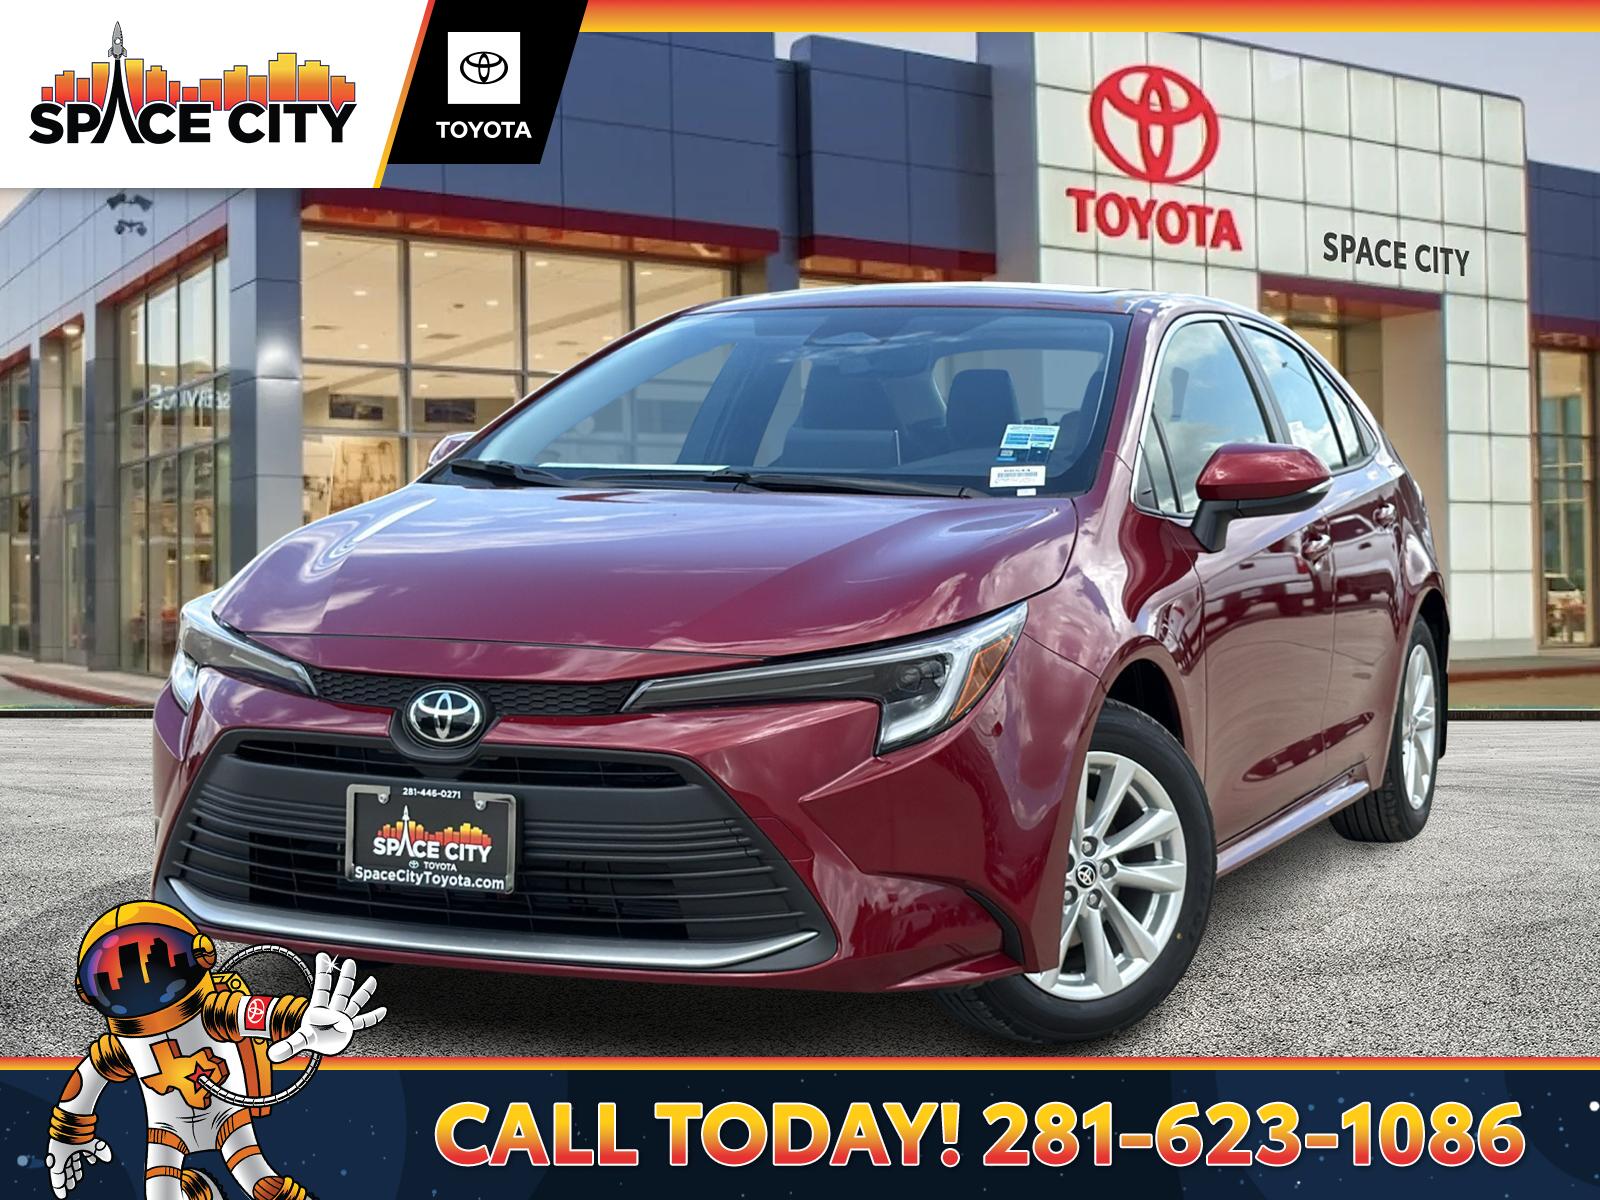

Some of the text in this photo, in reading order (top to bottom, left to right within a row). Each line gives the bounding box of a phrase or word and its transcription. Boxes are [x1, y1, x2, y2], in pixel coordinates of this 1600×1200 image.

[1066, 187, 1243, 251] TOYOTA
[1323, 231, 1470, 277] SPACE CITY
[373, 835, 492, 863] SPACE CITY
[355, 866, 504, 889] SpaceCityToyota.com
[423, 861, 457, 872] TOYOTA
